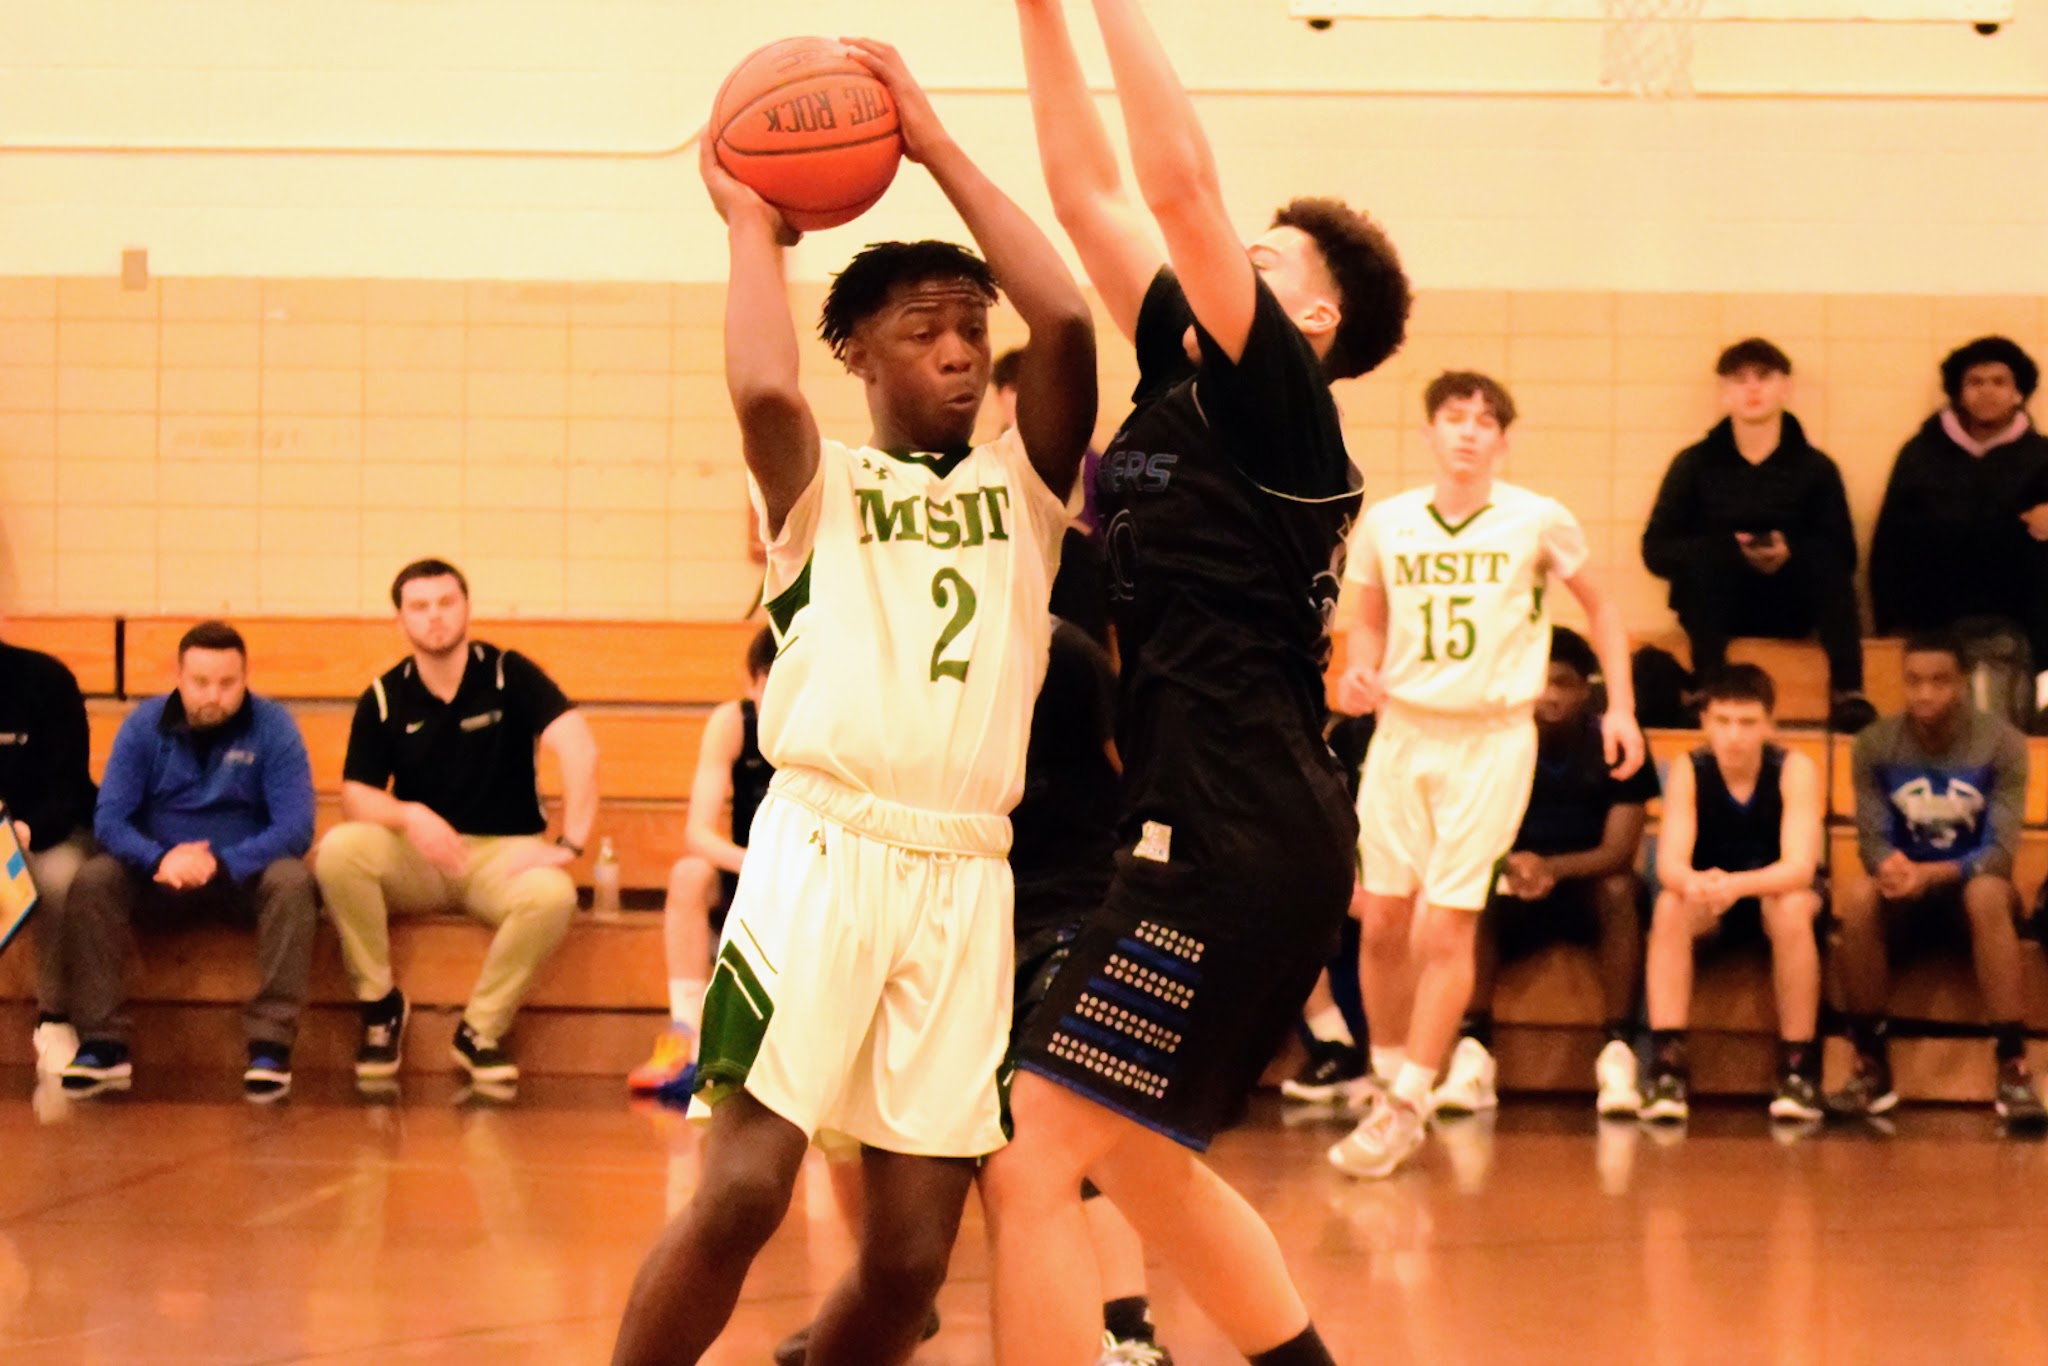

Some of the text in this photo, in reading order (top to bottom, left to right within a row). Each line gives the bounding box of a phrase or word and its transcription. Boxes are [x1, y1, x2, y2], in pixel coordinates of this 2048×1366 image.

[764, 86, 889, 132] THE ROCK
[855, 486, 1010, 549] MSIT
[1395, 552, 1509, 586] MSIT
[930, 567, 977, 683] 2
[1419, 595, 1476, 662] 15
